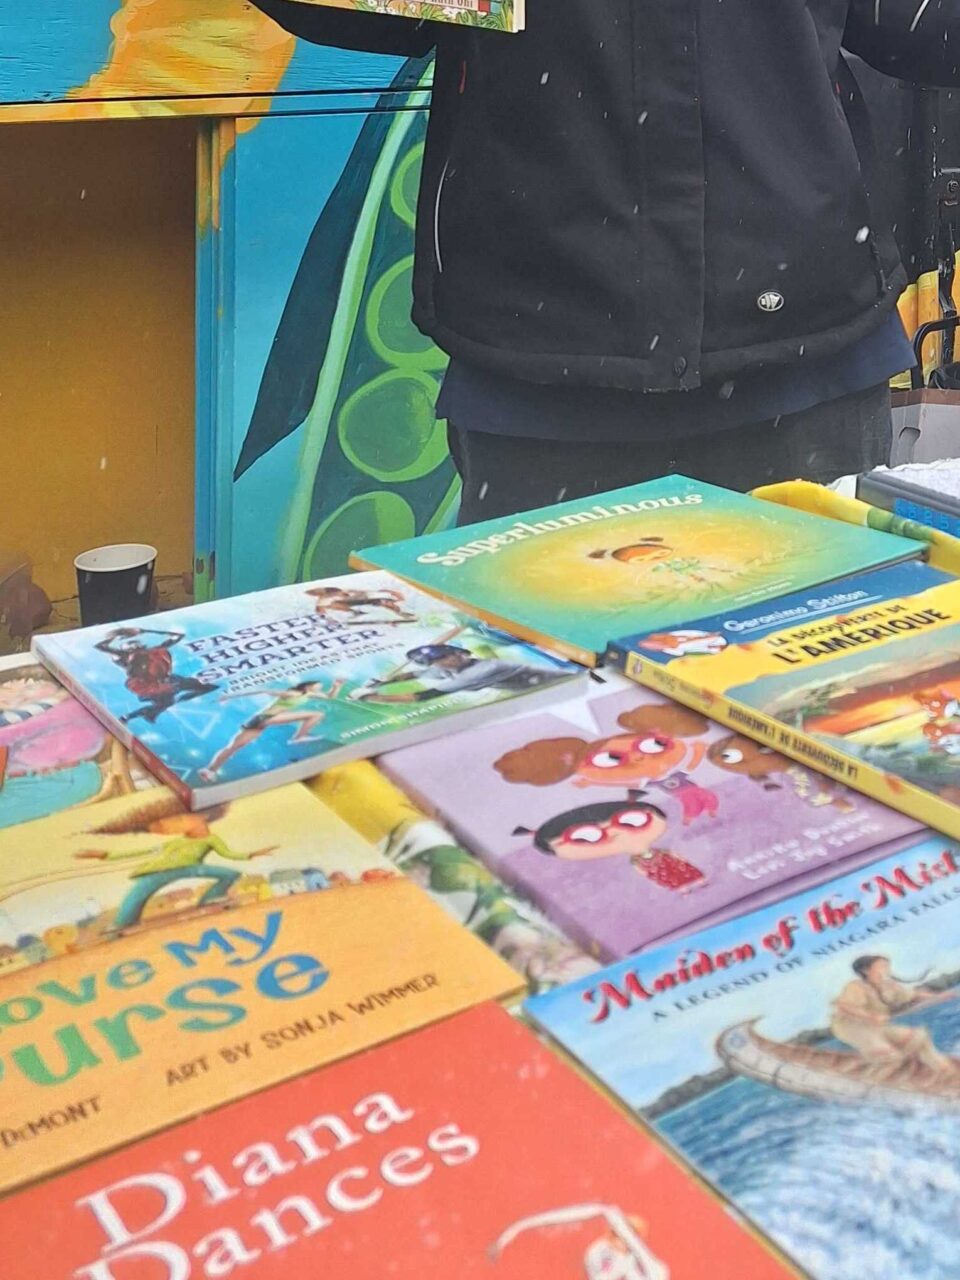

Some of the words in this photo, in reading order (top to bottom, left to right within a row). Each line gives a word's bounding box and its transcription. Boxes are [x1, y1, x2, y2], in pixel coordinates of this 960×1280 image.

[417, 490, 704, 567] Superluminous
[187, 612, 329, 653] FASTER
[199, 621, 349, 664] HIGHER
[722, 604, 808, 633] Geronimo
[806, 589, 869, 611] Stilton
[195, 628, 385, 683] SMARTER
[162, 909, 283, 968] My
[582, 948, 756, 1025] Maiden
[761, 916, 799, 958] of
[806, 892, 865, 934] the
[651, 1008, 669, 1023] A
[674, 970, 770, 1012] LEGEND
[774, 955, 803, 974] OF
[809, 913, 907, 960] NIAGARA
[165, 1055, 211, 1087] ART
[218, 1041, 253, 1065] BY
[260, 1009, 346, 1050] SONJA
[347, 971, 440, 1017] WIMMER
[72, 1123, 481, 1280] Dances
[74, 1091, 415, 1256] Diana
